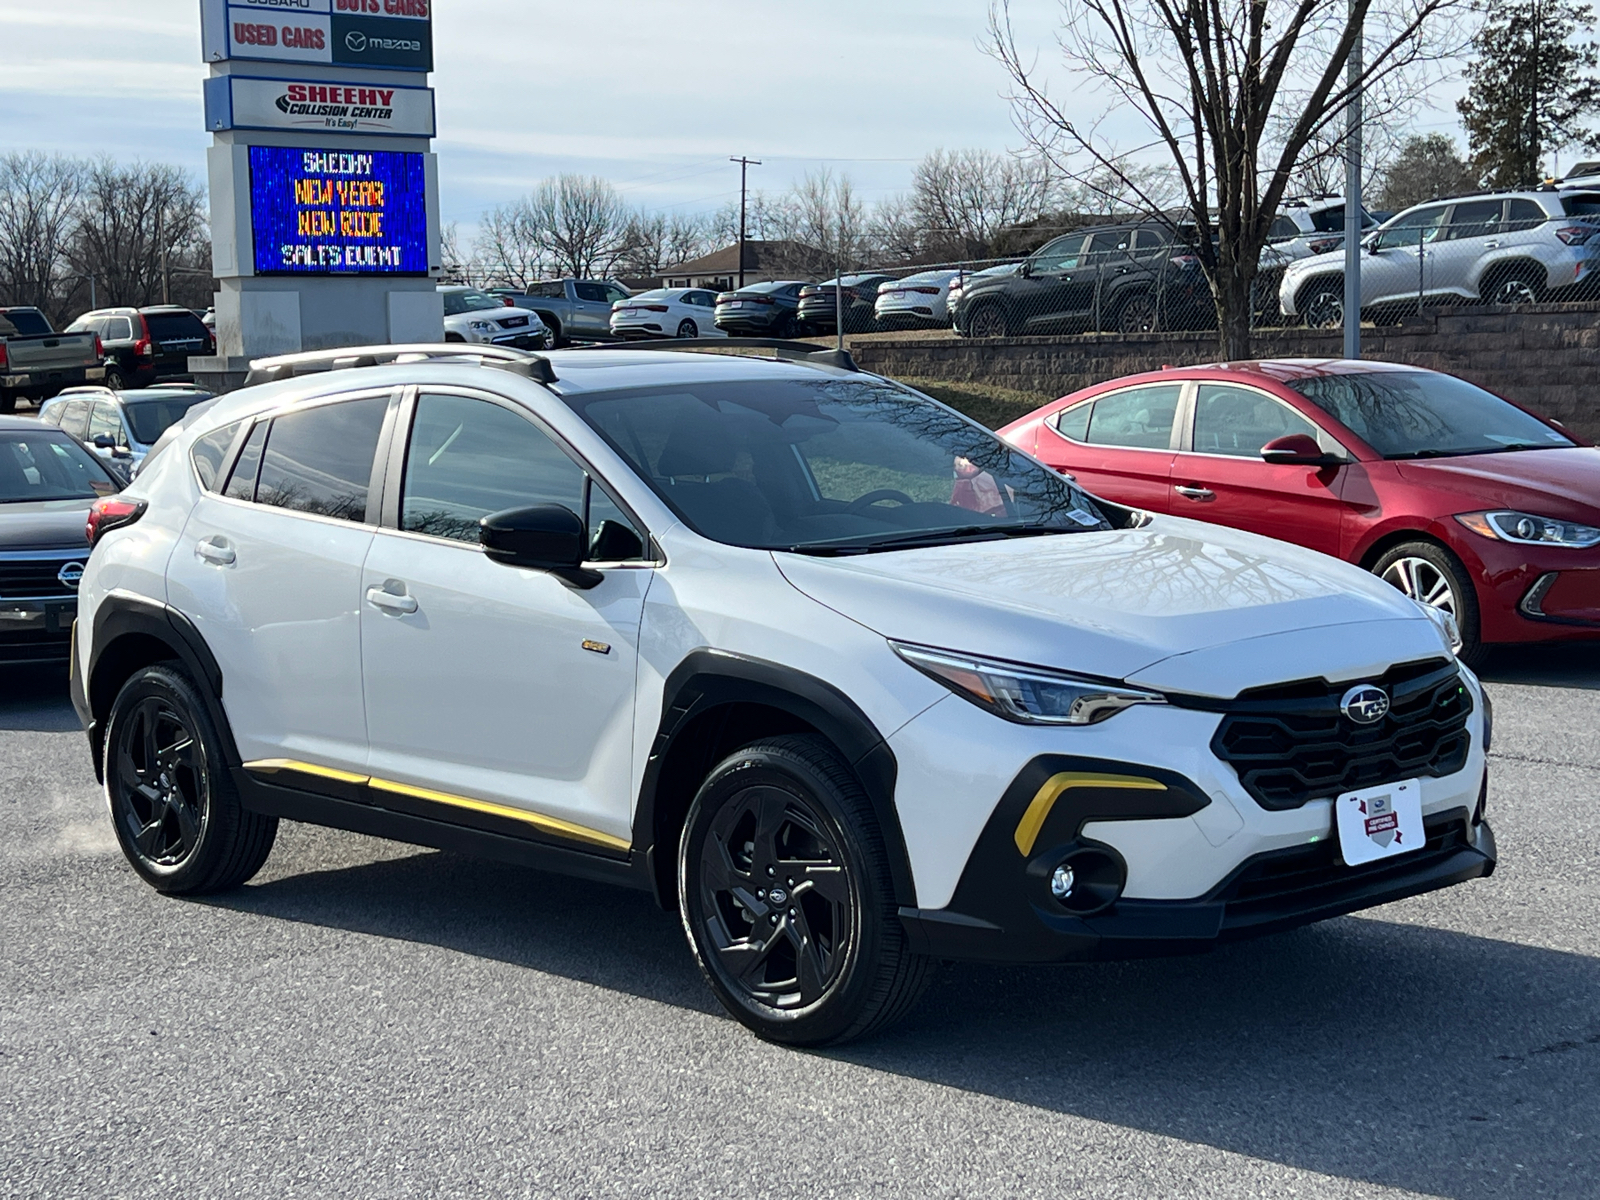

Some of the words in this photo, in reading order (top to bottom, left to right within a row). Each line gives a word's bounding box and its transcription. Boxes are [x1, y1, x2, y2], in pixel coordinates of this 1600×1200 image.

[384, 0, 428, 17] CARS
[234, 22, 277, 46] USED
[281, 26, 325, 50] CARS
[287, 84, 394, 106] SHEEHY
[289, 103, 349, 117] COLLISION
[350, 106, 393, 119] CENTER
[325, 117, 336, 127] It's
[337, 118, 358, 130] Easy!
[294, 179, 334, 205] NEW
[336, 180, 384, 207] YEAR
[298, 210, 335, 236] NEW
[281, 244, 342, 266] SALES
[344, 245, 401, 266] EVENT
